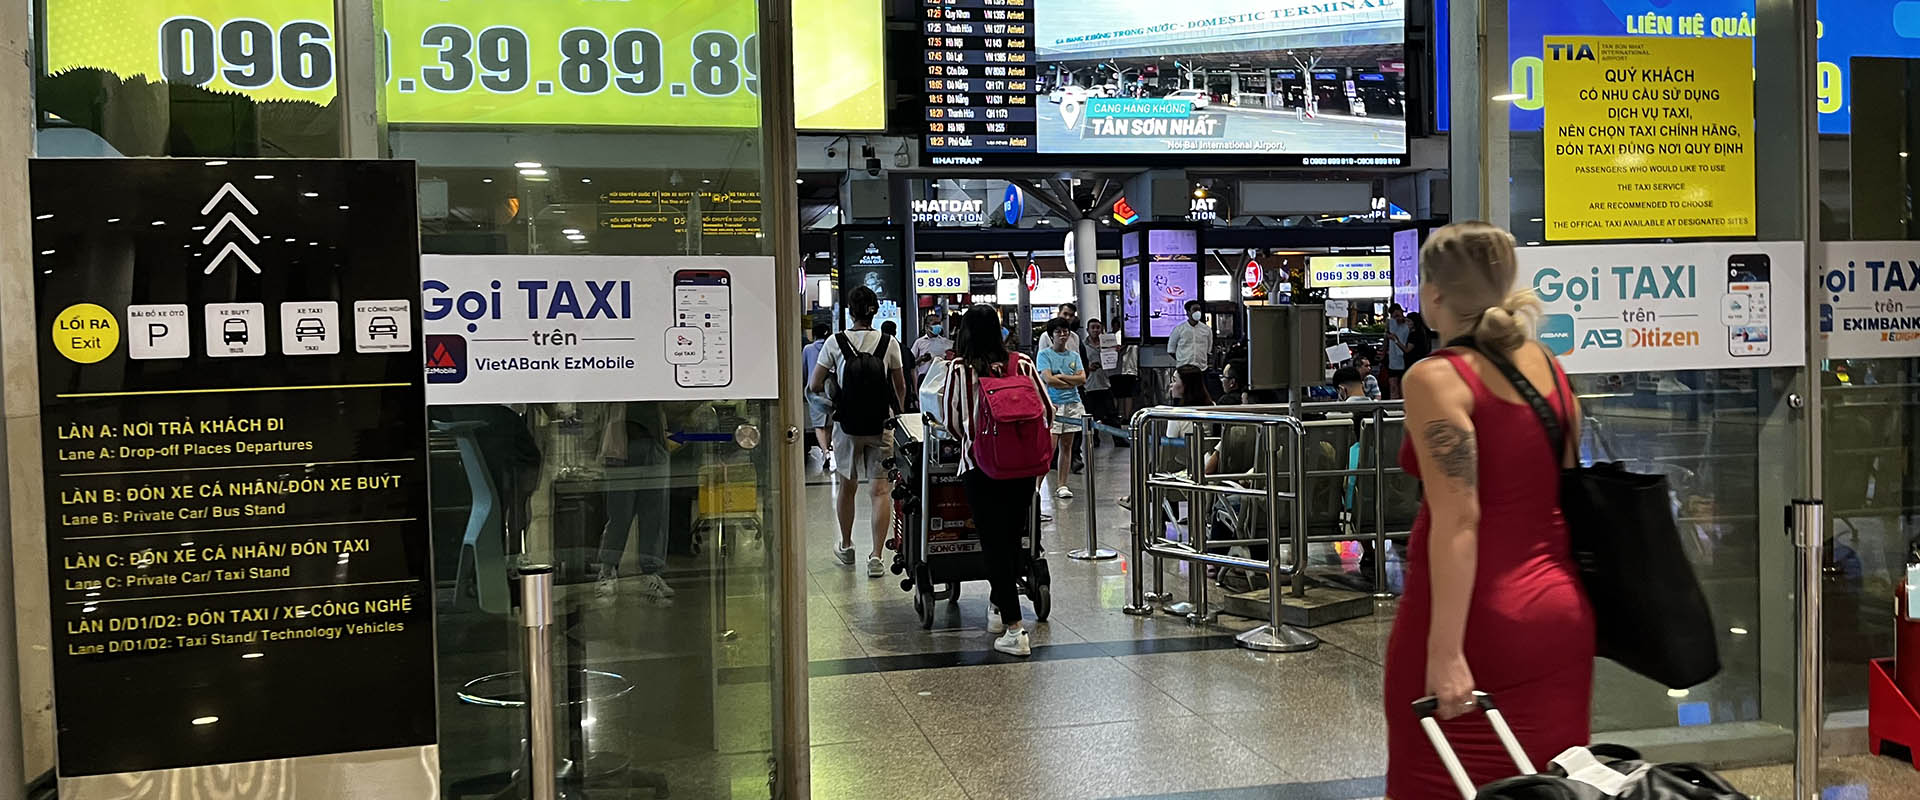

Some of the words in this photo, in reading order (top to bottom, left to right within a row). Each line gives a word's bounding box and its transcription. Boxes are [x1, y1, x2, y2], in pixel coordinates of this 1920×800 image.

[1188, 12, 1265, 29] DOMESTIC
[1271, 0, 1394, 18] TERMINAL
[1626, 11, 1672, 34] LIÊN
[1678, 12, 1704, 38] HỆ
[386, 25, 757, 96] .39.89.8
[1547, 44, 1596, 60] TIA
[1605, 66, 1636, 82] QUÝ
[1642, 66, 1694, 82] KHÁCH
[1580, 87, 1598, 100] CÓ
[1602, 90, 1628, 100] NHU
[1632, 85, 1658, 100] CẦU
[1662, 86, 1682, 100] SỬ
[1684, 89, 1720, 102] DỤNG
[1608, 108, 1638, 122] DỊCH
[1642, 108, 1659, 122] VỤ
[1663, 108, 1693, 120] TAXI,
[1092, 116, 1129, 136] TÂN
[1131, 117, 1170, 136] SƠN
[1170, 114, 1218, 136] NHẤT
[1558, 124, 1585, 137] NÊN
[1589, 126, 1625, 139] CHỌN
[1630, 125, 1656, 136] TAXI
[1660, 122, 1698, 136] CHÍNH
[1702, 122, 1741, 137] HÃNG,
[1200, 140, 1252, 149] International
[1556, 142, 1584, 156] ĐÓN
[1588, 144, 1615, 155] TAXI
[1618, 141, 1654, 155] ĐÚNG
[1658, 142, 1681, 154] NƠI
[1684, 143, 1711, 155] QUY
[1714, 143, 1744, 156] ĐỊNH
[1576, 166, 1627, 174] PASSENGERS
[1650, 165, 1678, 173] WOULD
[1589, 202, 1604, 210] ARE
[1607, 201, 1667, 209] RECOMMENDED
[1553, 221, 1568, 229] THE
[1570, 220, 1602, 228] OFFICAL
[1605, 220, 1622, 228] TAXI
[1624, 219, 1664, 227] AVAILABLE
[1678, 218, 1726, 226] DESIGNATED
[1728, 217, 1749, 225] SITES
[1533, 266, 1599, 312] Gọi
[1611, 266, 1696, 300] TAXI
[1819, 261, 1855, 302] ọi
[422, 280, 501, 332] Gọi
[518, 280, 631, 319] TAXI
[1874, 300, 1903, 313] trên
[60, 315, 84, 330] LỐI
[90, 319, 110, 329] RA
[1622, 308, 1656, 322] trên
[1843, 317, 1920, 330] EXIMBANK
[72, 336, 101, 349] Exit
[148, 324, 168, 347] P
[532, 329, 577, 346] trên
[475, 357, 560, 371] VietABank
[564, 356, 634, 370] EzMobile
[58, 422, 94, 439] LÀN
[100, 424, 118, 438] A:
[123, 420, 153, 436] NƠI
[158, 416, 194, 435] TRẢ
[200, 416, 262, 434] KHÁCH
[267, 418, 284, 431] ĐI
[59, 449, 95, 460] Lane
[100, 448, 116, 459] A:
[120, 444, 180, 459] Drop-off
[184, 443, 232, 455] Places
[236, 441, 313, 454] Departures
[61, 488, 97, 504] LÀN
[103, 490, 121, 502] B:
[127, 484, 165, 501] ĐÓN
[171, 486, 194, 499] XE
[199, 481, 224, 497] CÁ
[330, 477, 352, 491] XE
[357, 472, 401, 489] BUÝT
[62, 514, 98, 526] Lane
[103, 512, 119, 523] B:
[123, 510, 175, 522] Private
[178, 506, 208, 519] Car/
[212, 506, 240, 518] Bus
[244, 503, 286, 516] Stand
[64, 552, 100, 569] LÀN
[106, 554, 124, 567] C:
[129, 548, 168, 565] ĐÓN
[174, 549, 197, 563] XE
[202, 544, 226, 561] CÁ
[232, 542, 286, 559] NHÂN/
[291, 539, 327, 556] ĐÓN
[332, 539, 370, 553] TAXI
[66, 579, 102, 590] Lane
[106, 577, 122, 588] C:
[126, 574, 177, 587] Private
[181, 570, 211, 583] Car/
[215, 569, 245, 581] Taxi
[249, 566, 290, 579] Stand
[68, 617, 103, 634] LÀN
[109, 615, 182, 632] D/D1/D2:
[187, 608, 224, 626] ĐÓN
[229, 608, 268, 622] TAXI
[273, 607, 280, 620] /
[283, 606, 305, 619] XE
[311, 600, 360, 617] CÔNG
[365, 595, 412, 613] NGHỆ
[69, 644, 104, 655] Lane
[109, 640, 172, 653] D/D1/D2:
[176, 635, 207, 647] Taxi
[211, 630, 258, 644] Stand/
[261, 626, 342, 640] Technology
[346, 622, 404, 635] Vehicles
